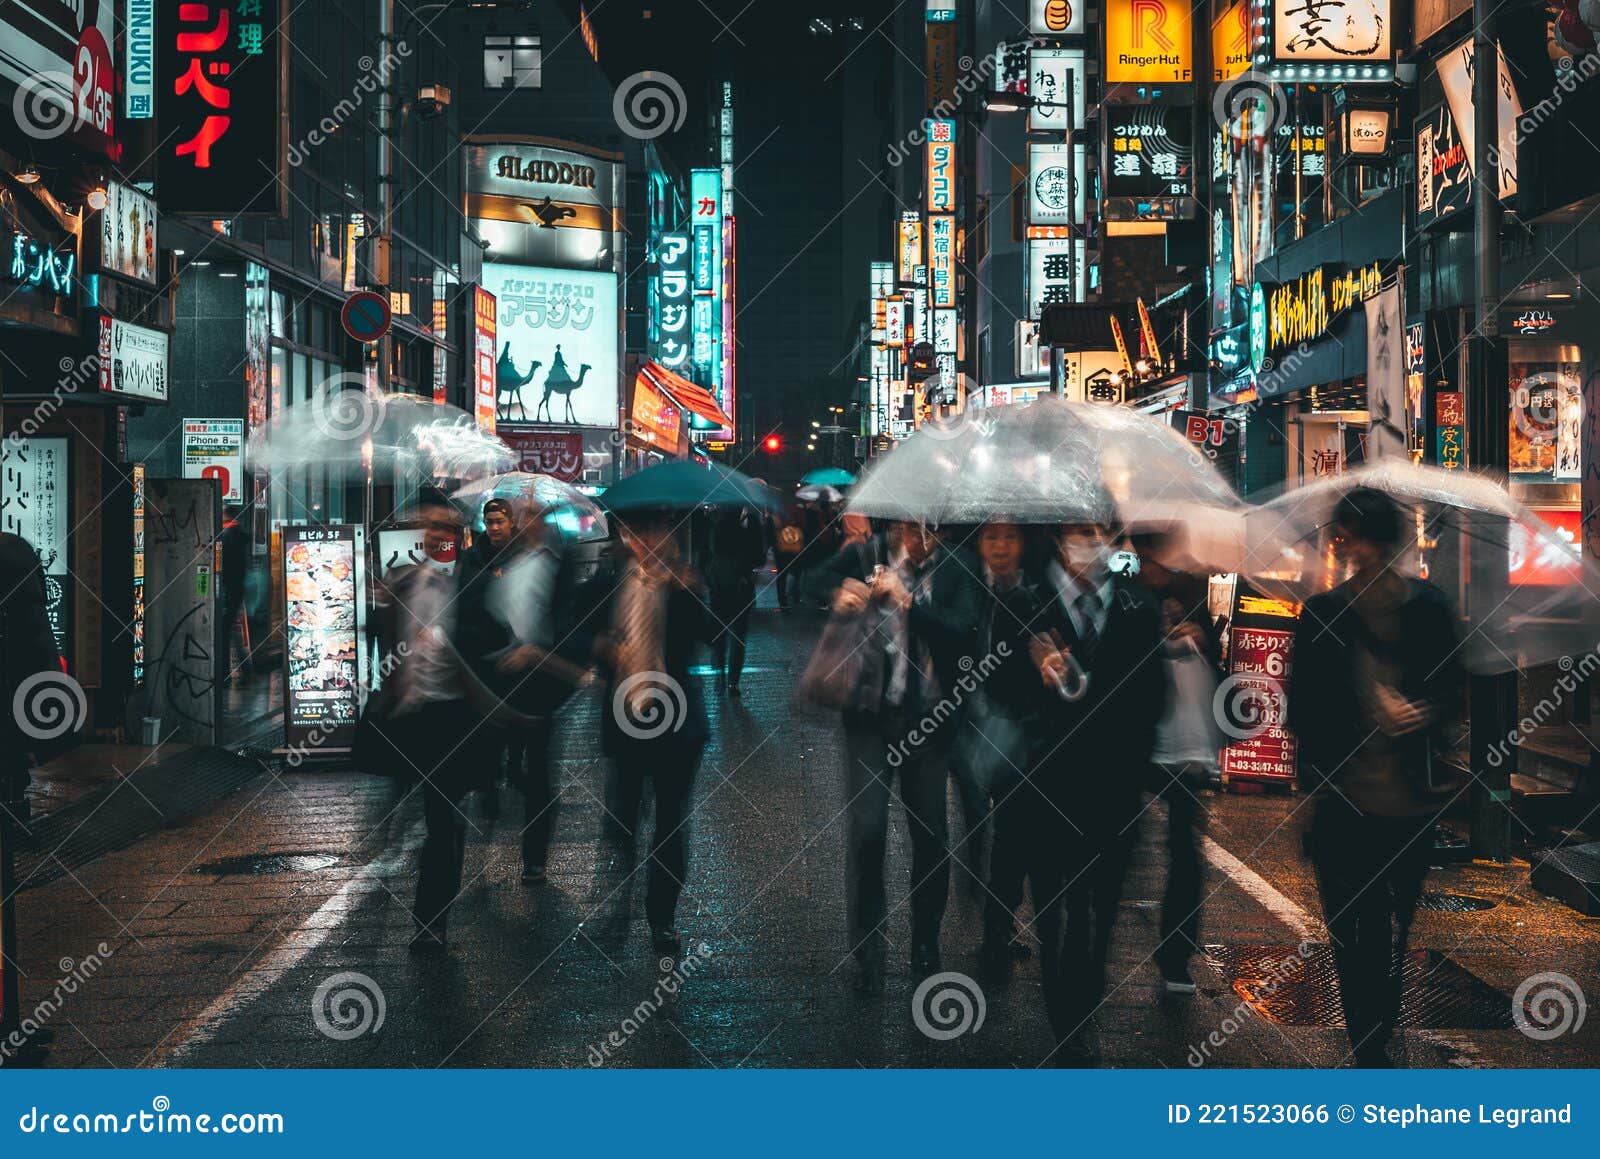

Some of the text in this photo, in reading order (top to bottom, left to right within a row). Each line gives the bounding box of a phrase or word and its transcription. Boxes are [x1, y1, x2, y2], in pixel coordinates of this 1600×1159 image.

[933, 11, 949, 20] 4F
[1119, 54, 1180, 66] Ringer Hut
[175, 4, 231, 168] ンベイ
[1174, 70, 1191, 80] 1F
[933, 122, 950, 141] 薬
[1113, 125, 1167, 136] つけめん
[496, 155, 596, 189] ALADDIN
[933, 147, 950, 207] ダイコク
[1171, 184, 1187, 194] B1
[934, 219, 949, 304] 新宿11号店
[501, 279, 594, 299] パチンコ パチスロ
[661, 236, 688, 366] アラジン
[500, 294, 594, 331] アラジン
[188, 436, 219, 445] iPhone
[222, 436, 229, 445] 8
[1186, 416, 1224, 446] B1
[1442, 394, 1461, 472] 予約受付中
[522, 450, 578, 474] ラジン
